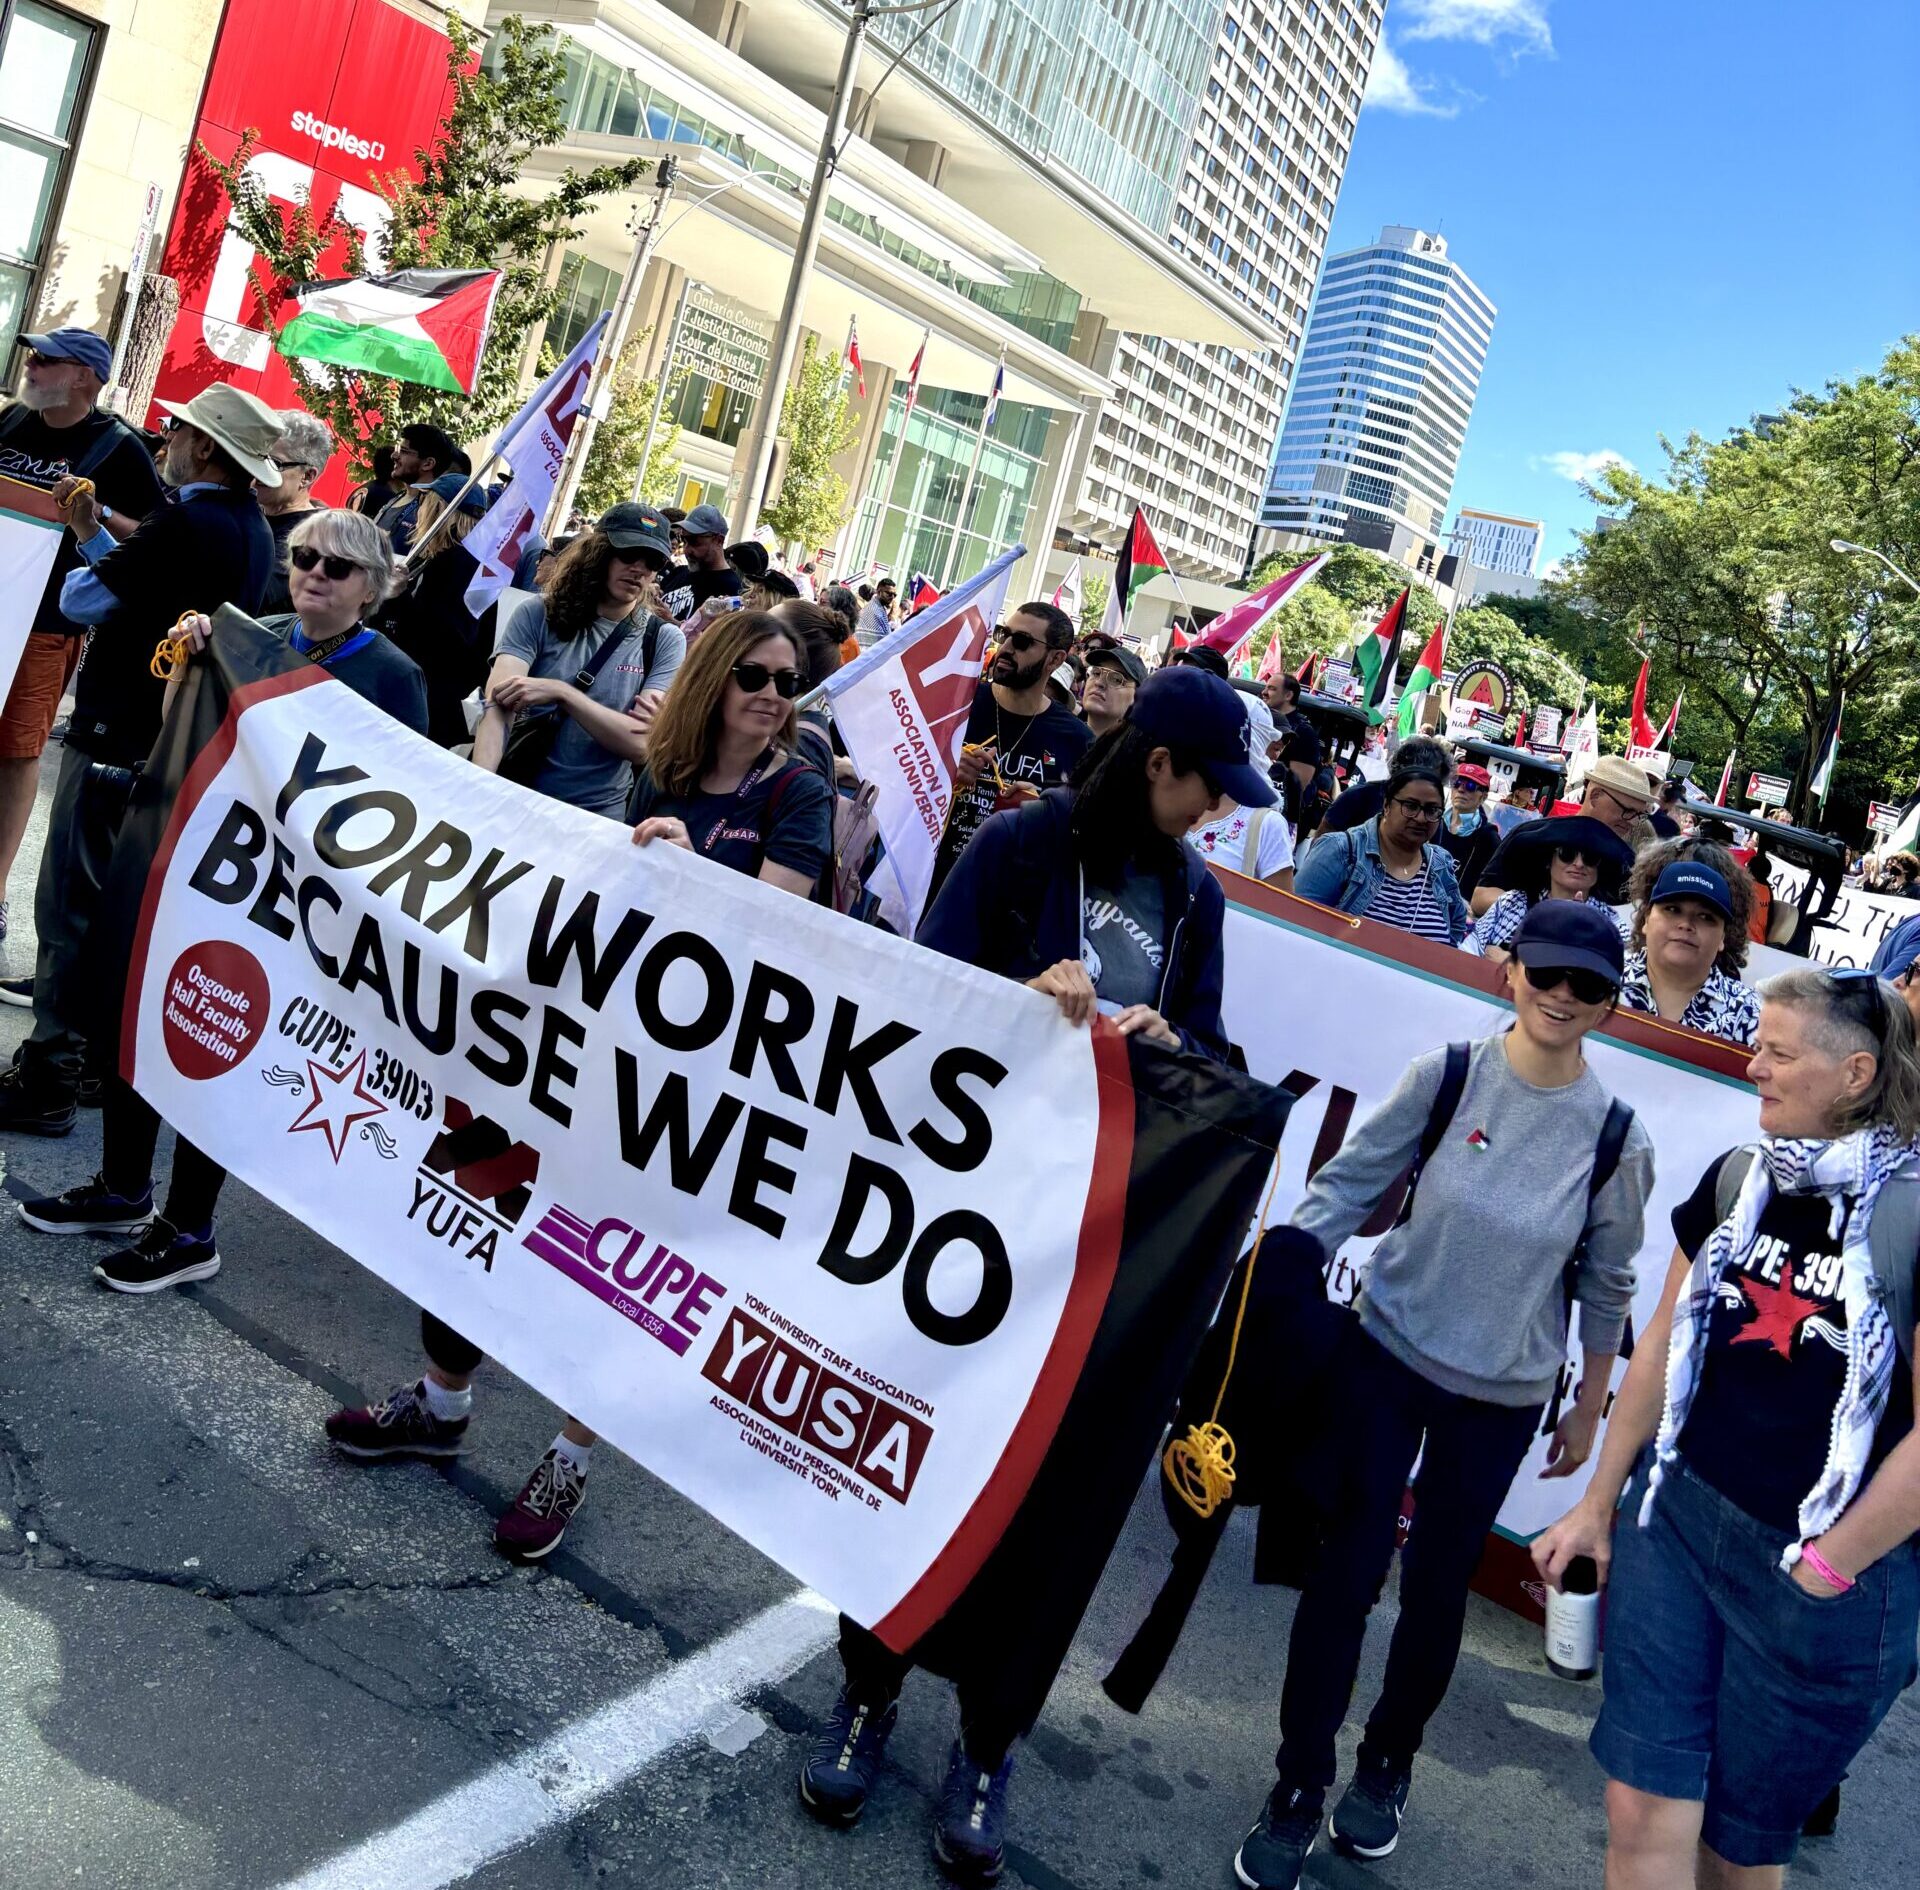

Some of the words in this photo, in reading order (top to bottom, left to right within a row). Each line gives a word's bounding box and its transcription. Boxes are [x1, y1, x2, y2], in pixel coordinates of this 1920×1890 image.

[290, 110, 370, 160] staples
[679, 329, 706, 352] Cour
[707, 342, 721, 358] de
[690, 315, 730, 338] Justice
[732, 328, 768, 356] Toronto
[693, 290, 733, 319] Ontario
[735, 309, 764, 332] Court
[888, 688, 943, 794] ASSOCIATION
[996, 752, 1044, 783] YUFA
[1494, 761, 1514, 776] 10
[275, 731, 536, 964] YORK
[527, 874, 1010, 1173] WORKS
[171, 977, 198, 1009] Hall
[195, 996, 251, 1043] Faculty
[187, 964, 251, 1013] Osgoode
[165, 1000, 238, 1063] Association
[278, 995, 356, 1070] CUPE
[366, 1047, 434, 1121] 3903
[187, 798, 587, 1130] BECAUSE
[614, 1045, 809, 1241] WE
[816, 1150, 1013, 1347] DO
[406, 1176, 499, 1274] YUFA
[583, 1216, 729, 1338] CUPE
[610, 1291, 640, 1320] Local
[640, 1306, 665, 1337] 1356
[744, 1291, 769, 1320] YORK
[769, 1310, 823, 1354] UNIVERSITY
[820, 1347, 854, 1373] STAFF
[850, 1366, 935, 1419] ASSOCIATION
[720, 1317, 912, 1494] YUSA
[709, 1394, 782, 1447] ASSOCIATION
[782, 1440, 802, 1459] DU
[802, 1451, 866, 1504] PERSONNEL
[864, 1492, 883, 1512] DE
[739, 1428, 810, 1480] L'UNIVERSITÉ
[810, 1471, 842, 1502] YORK
